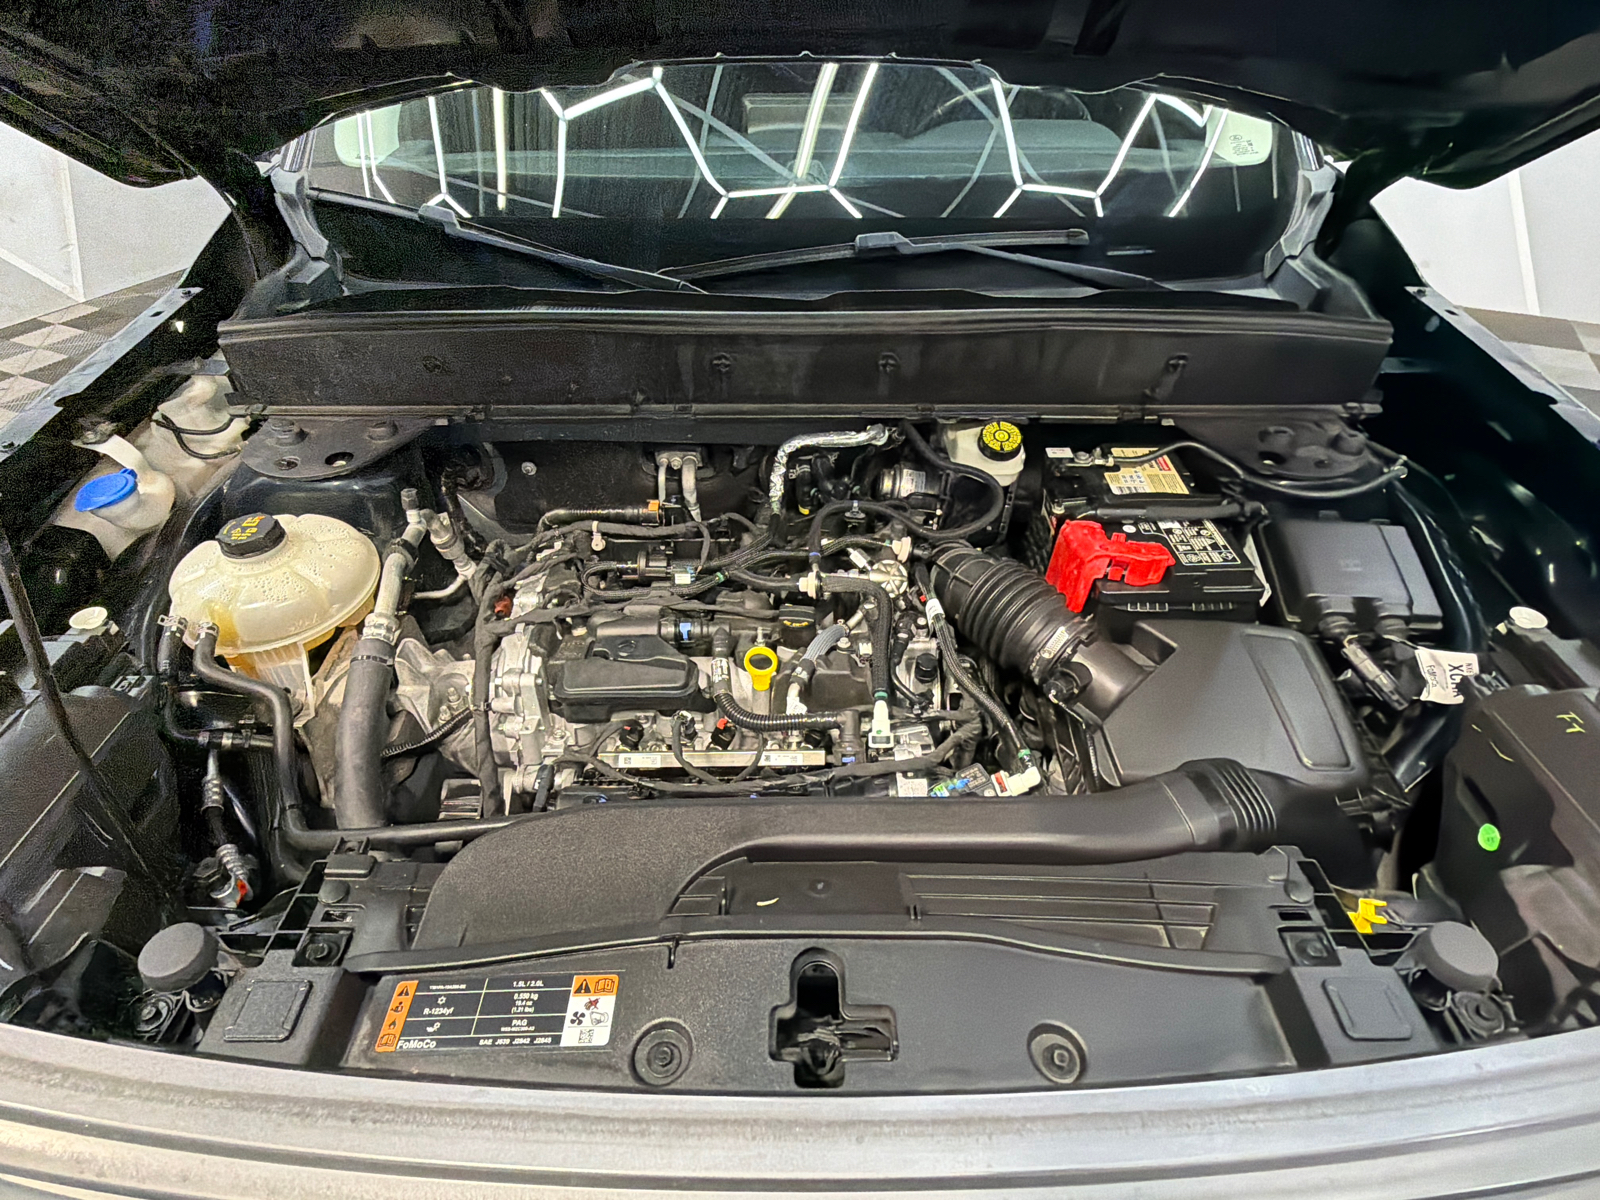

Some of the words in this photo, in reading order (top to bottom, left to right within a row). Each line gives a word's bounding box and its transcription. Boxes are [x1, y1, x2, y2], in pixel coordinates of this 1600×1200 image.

[530, 992, 539, 1001] kg
[423, 1007, 454, 1015] R-1234yf
[397, 1039, 436, 1049] FoMoCo
